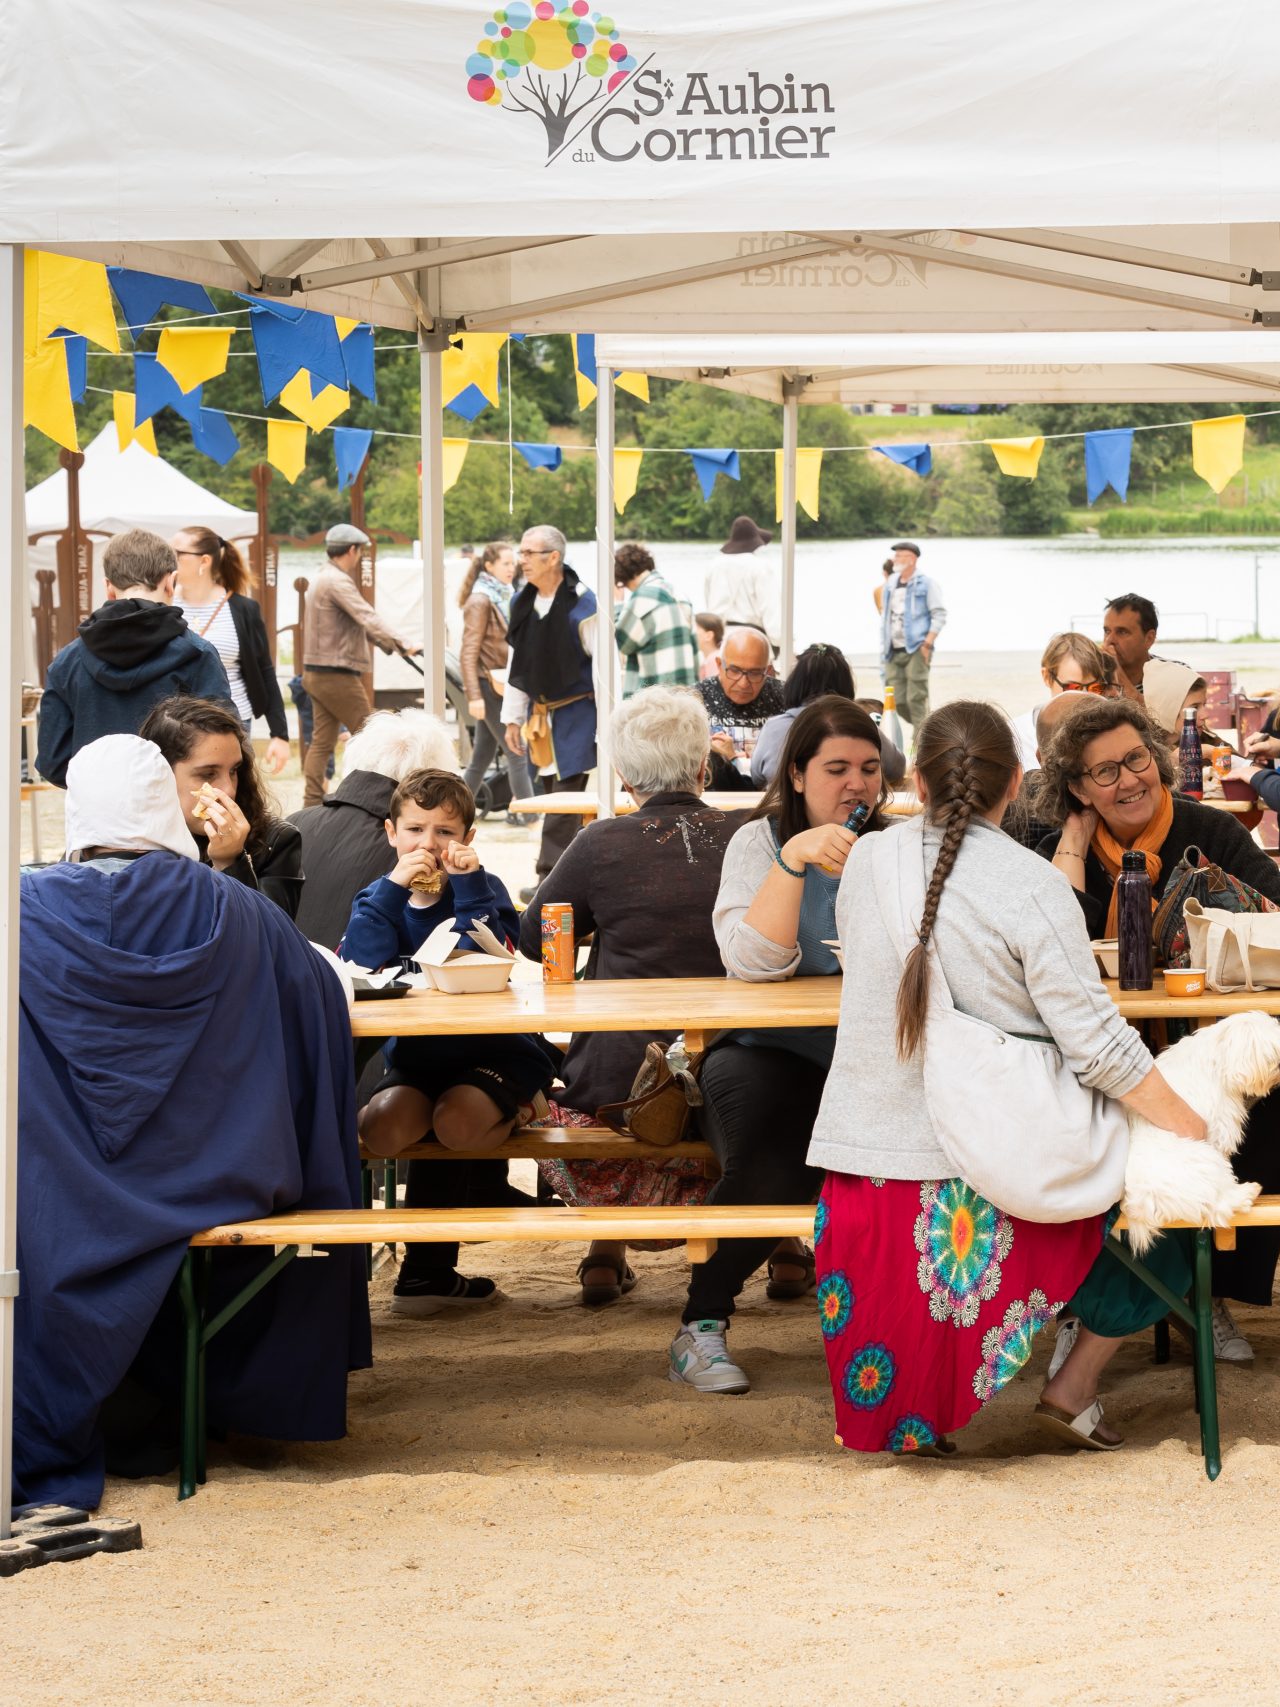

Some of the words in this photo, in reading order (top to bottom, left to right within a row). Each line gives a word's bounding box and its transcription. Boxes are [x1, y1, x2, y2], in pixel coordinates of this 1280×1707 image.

[676, 71, 835, 116] Aubin
[572, 149, 595, 163] du
[591, 107, 836, 162] Cormier
